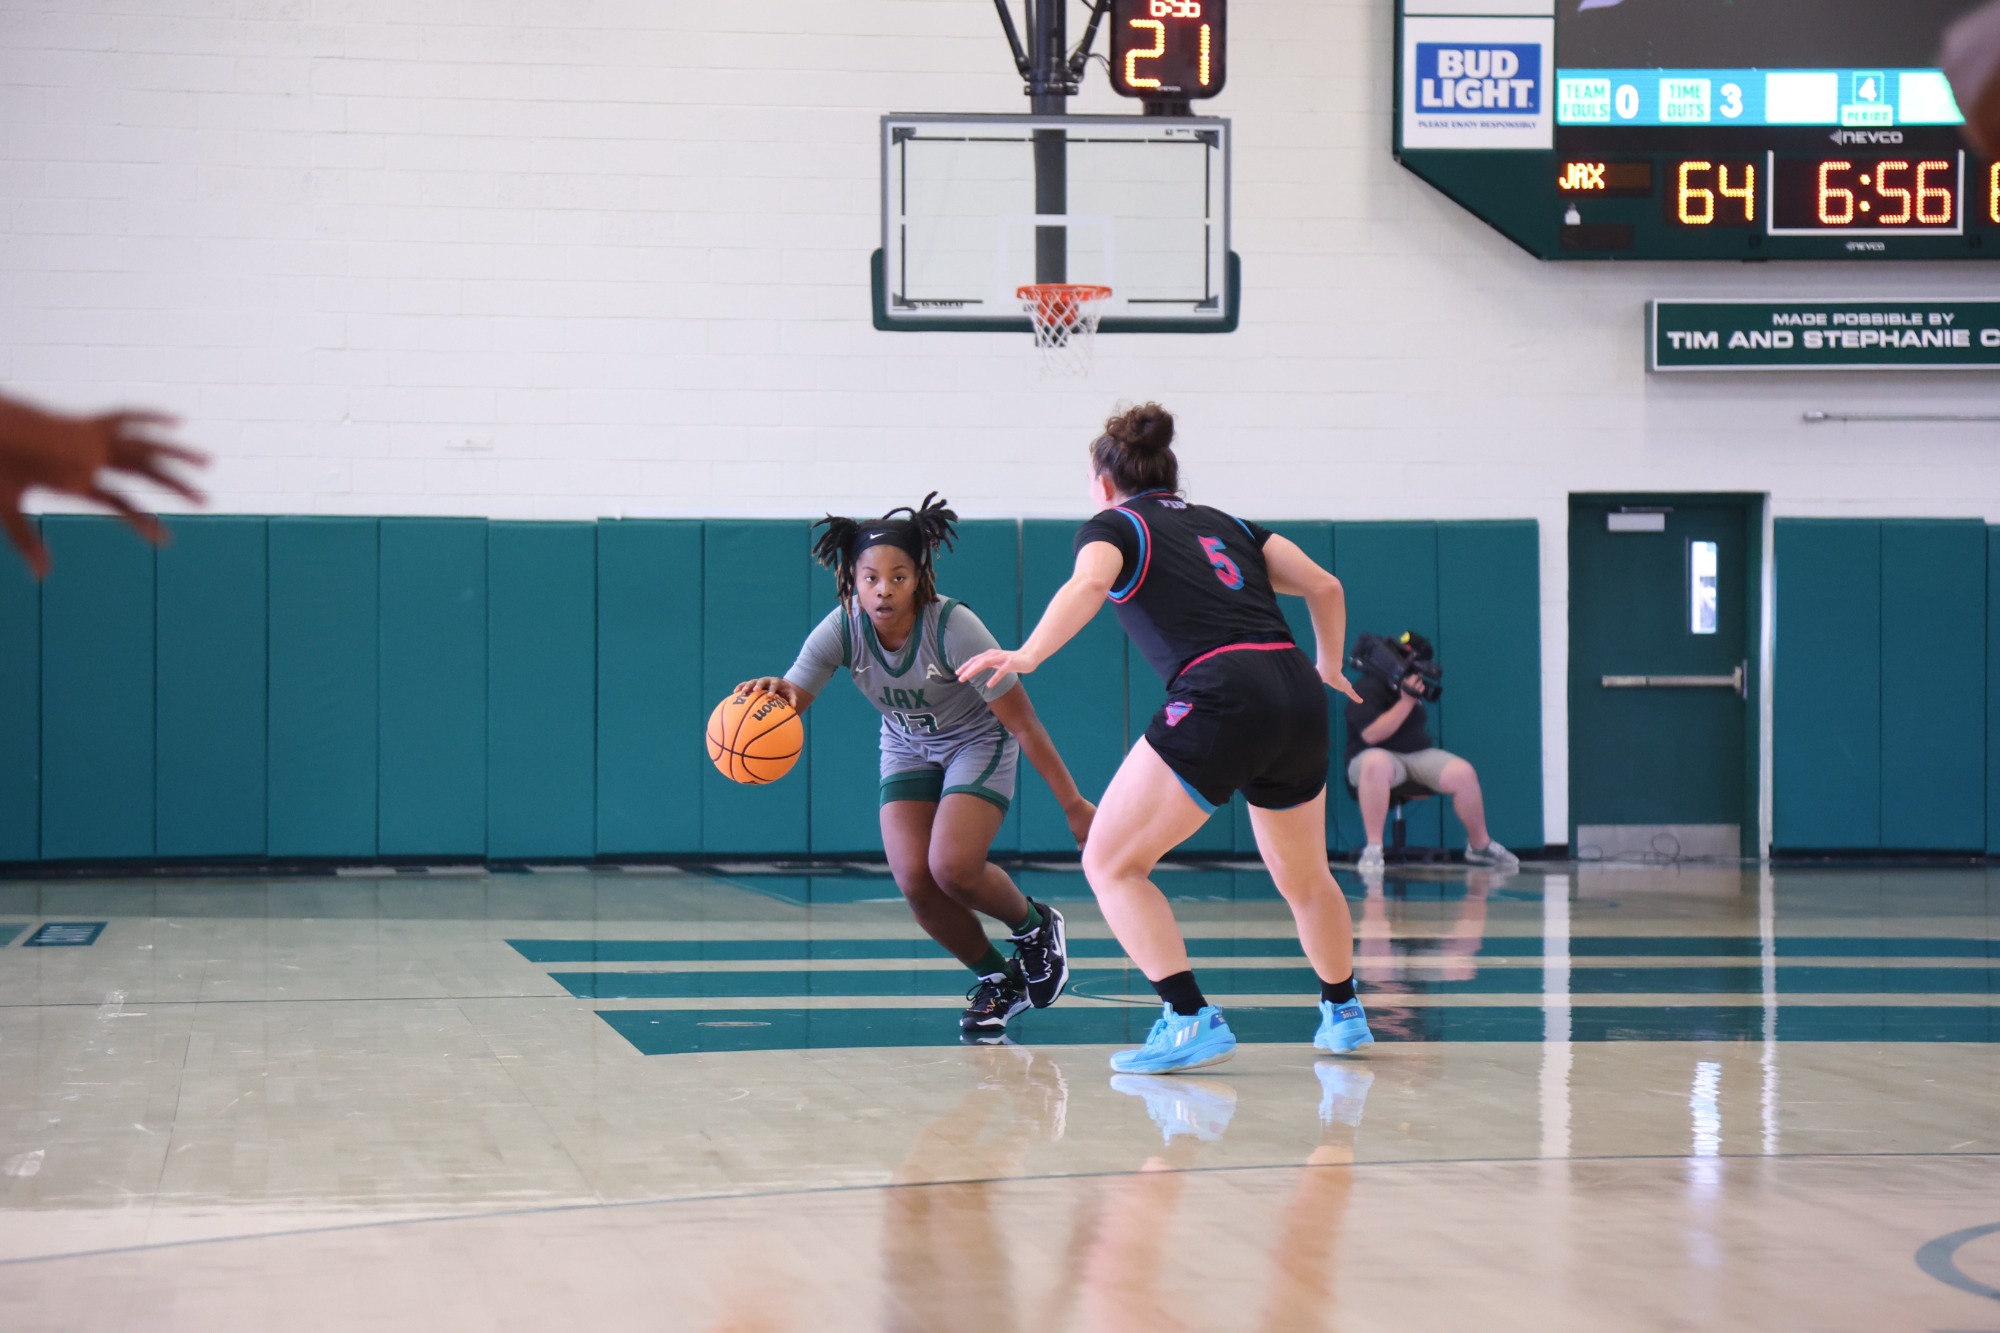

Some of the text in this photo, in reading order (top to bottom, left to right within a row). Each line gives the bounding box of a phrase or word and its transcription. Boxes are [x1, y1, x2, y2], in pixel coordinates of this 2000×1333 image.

[1125, 19, 1210, 87] 21
[1437, 49, 1519, 79] BUD
[1421, 78, 1535, 108] LIGHT
[1566, 84, 1606, 99] TEAM
[1615, 83, 1640, 120] 0
[1669, 84, 1703, 99] TIME
[1719, 82, 1744, 119] 3
[1858, 76, 1878, 102] 4
[1563, 103, 1609, 117] FOULS
[1667, 103, 1705, 117] OUTS
[1558, 162, 1606, 190] JAX
[1678, 161, 1755, 224] 64
[1818, 161, 1952, 224] 6:56
[1772, 313, 1955, 326] MADE POSSIBLE BY
[1666, 331, 1719, 349] TIM
[1728, 331, 1794, 349] AND
[1803, 329, 1971, 349] STEPHANIE
[1197, 534, 1244, 590] 5
[879, 686, 932, 709] JAX
